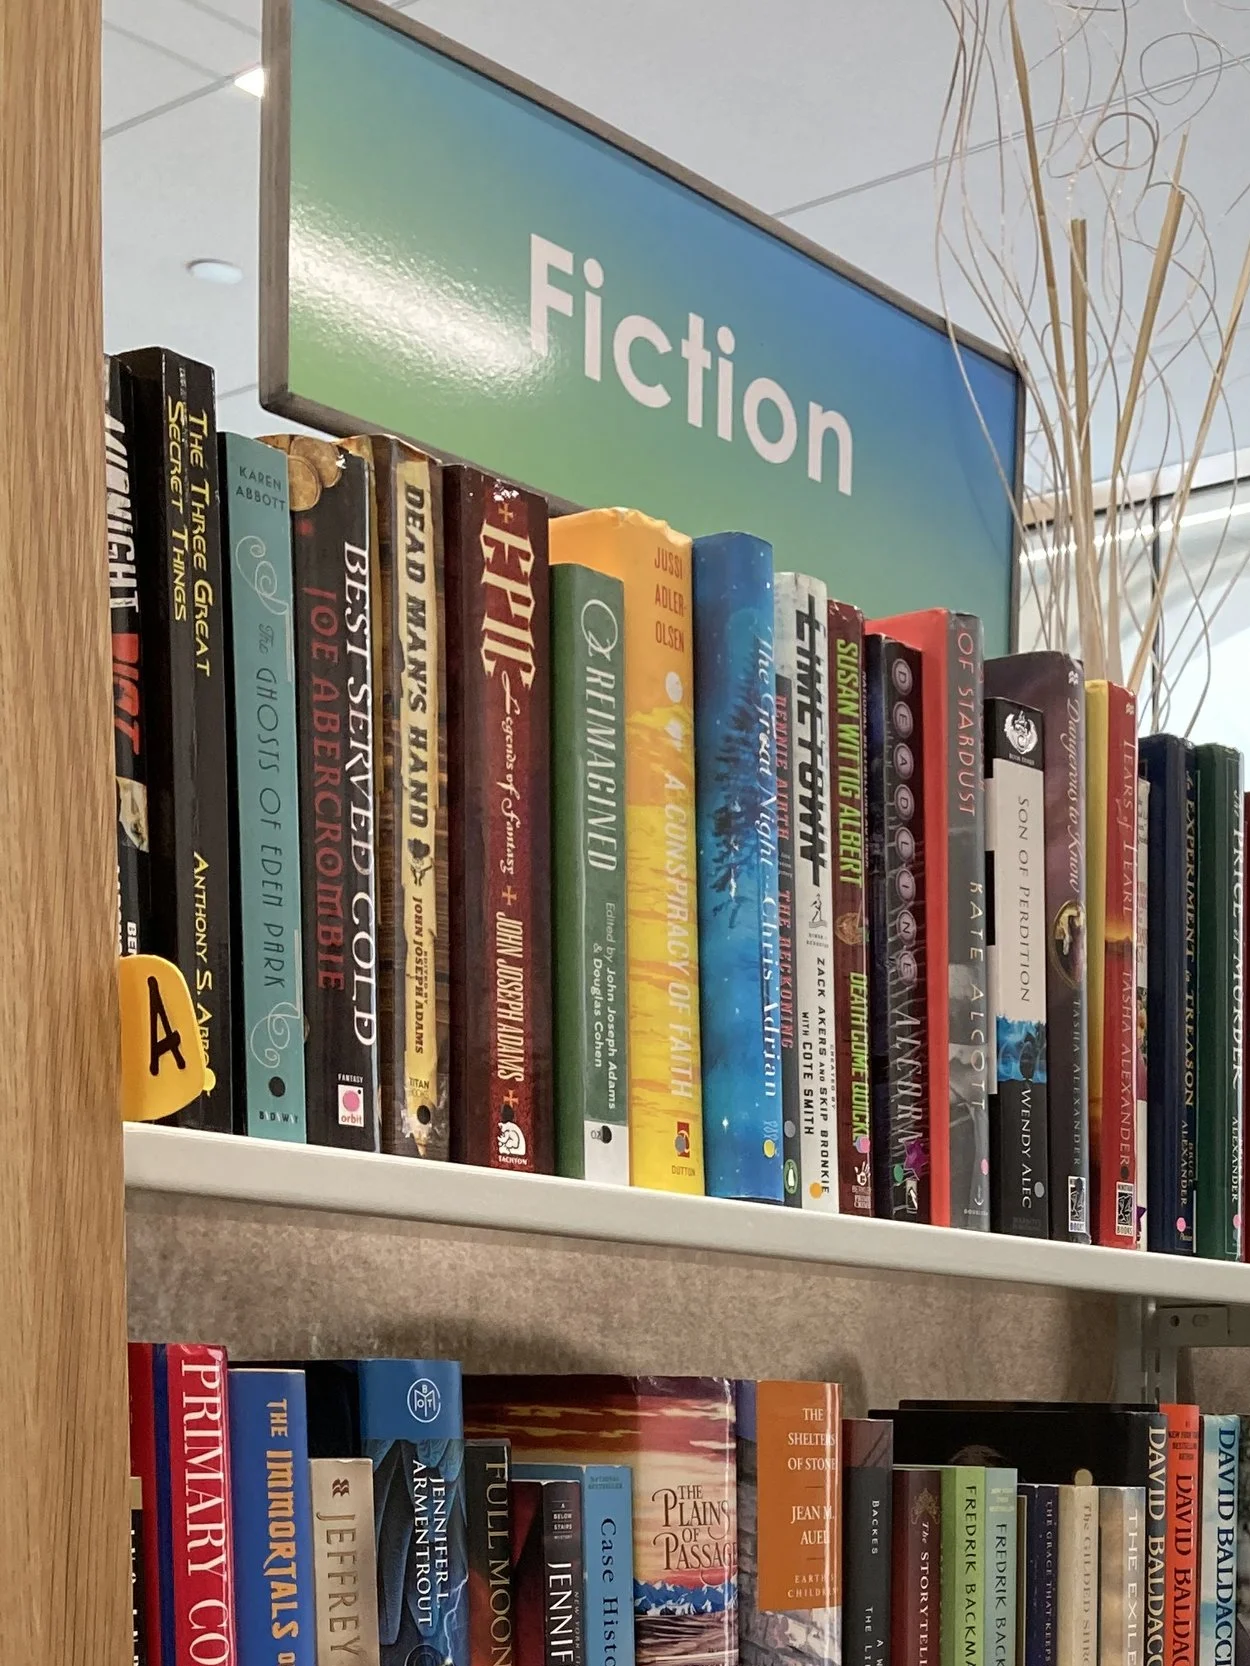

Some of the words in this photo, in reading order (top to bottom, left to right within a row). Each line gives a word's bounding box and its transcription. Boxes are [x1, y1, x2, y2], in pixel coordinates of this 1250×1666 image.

[530, 233, 854, 497] Fiction
[167, 396, 186, 515] SECRET
[235, 486, 287, 512] ABBOTT
[239, 465, 283, 493] KAREN
[191, 480, 210, 573] THREE
[402, 483, 427, 585] DEAD
[654, 546, 684, 580] JUSSI
[171, 527, 189, 622] THINGS
[342, 540, 371, 663] BEST
[479, 518, 537, 691] EPIC
[193, 579, 213, 677] GREAT
[404, 597, 428, 714] MAN'S
[655, 619, 685, 653] OLSEN
[255, 668, 281, 772] GHOSTS
[836, 638, 860, 717] SUSAN
[345, 675, 376, 877] SERVED
[402, 729, 430, 829] HAND
[584, 665, 618, 872] REIMAGINED
[837, 722, 861, 799] WITTIG
[957, 684, 976, 817] STARDUST
[310, 678, 345, 992] ABERCROMBIE
[838, 802, 863, 889] ALBERT
[1017, 796, 1029, 842] SON
[192, 851, 209, 965] ANTHONY
[260, 844, 284, 909] EDEN
[664, 803, 690, 976] CONSPIRACY
[969, 881, 984, 963] KATE
[261, 923, 287, 990] PARK
[350, 890, 378, 1047] COLD
[591, 958, 605, 1017] Douglas
[1018, 885, 1031, 1004] PERDITION
[147, 976, 186, 1076] A
[606, 1002, 619, 1057] Joseph
[970, 983, 987, 1111] ALCOTT
[1120, 971, 1133, 1036] TASHA
[337, 1072, 365, 1085] FANTASY
[607, 1060, 618, 1110] Adams
[669, 1022, 694, 1099] FAITH
[1118, 1042, 1133, 1167] ALEXANDER
[339, 1112, 364, 1127] orbit
[1020, 1088, 1033, 1158] WENDY
[1020, 1163, 1032, 1210] ALEC
[265, 1397, 289, 1439] THE
[801, 1407, 825, 1422] THE
[181, 1358, 227, 1586] PRIMARY
[790, 1505, 822, 1525] JEAN
[1173, 1472, 1195, 1557] DAVID
[1216, 1426, 1237, 1522] DAVID
[262, 1449, 299, 1641] IMMORTALS
[412, 1458, 436, 1627] ARMENTROUT
[428, 1476, 451, 1587] JENNIFER
[600, 1517, 619, 1585] Case
[963, 1485, 977, 1576] FREDRIK
[995, 1523, 1008, 1610] FREDRIK
[316, 1513, 362, 1656] JEFFREY
